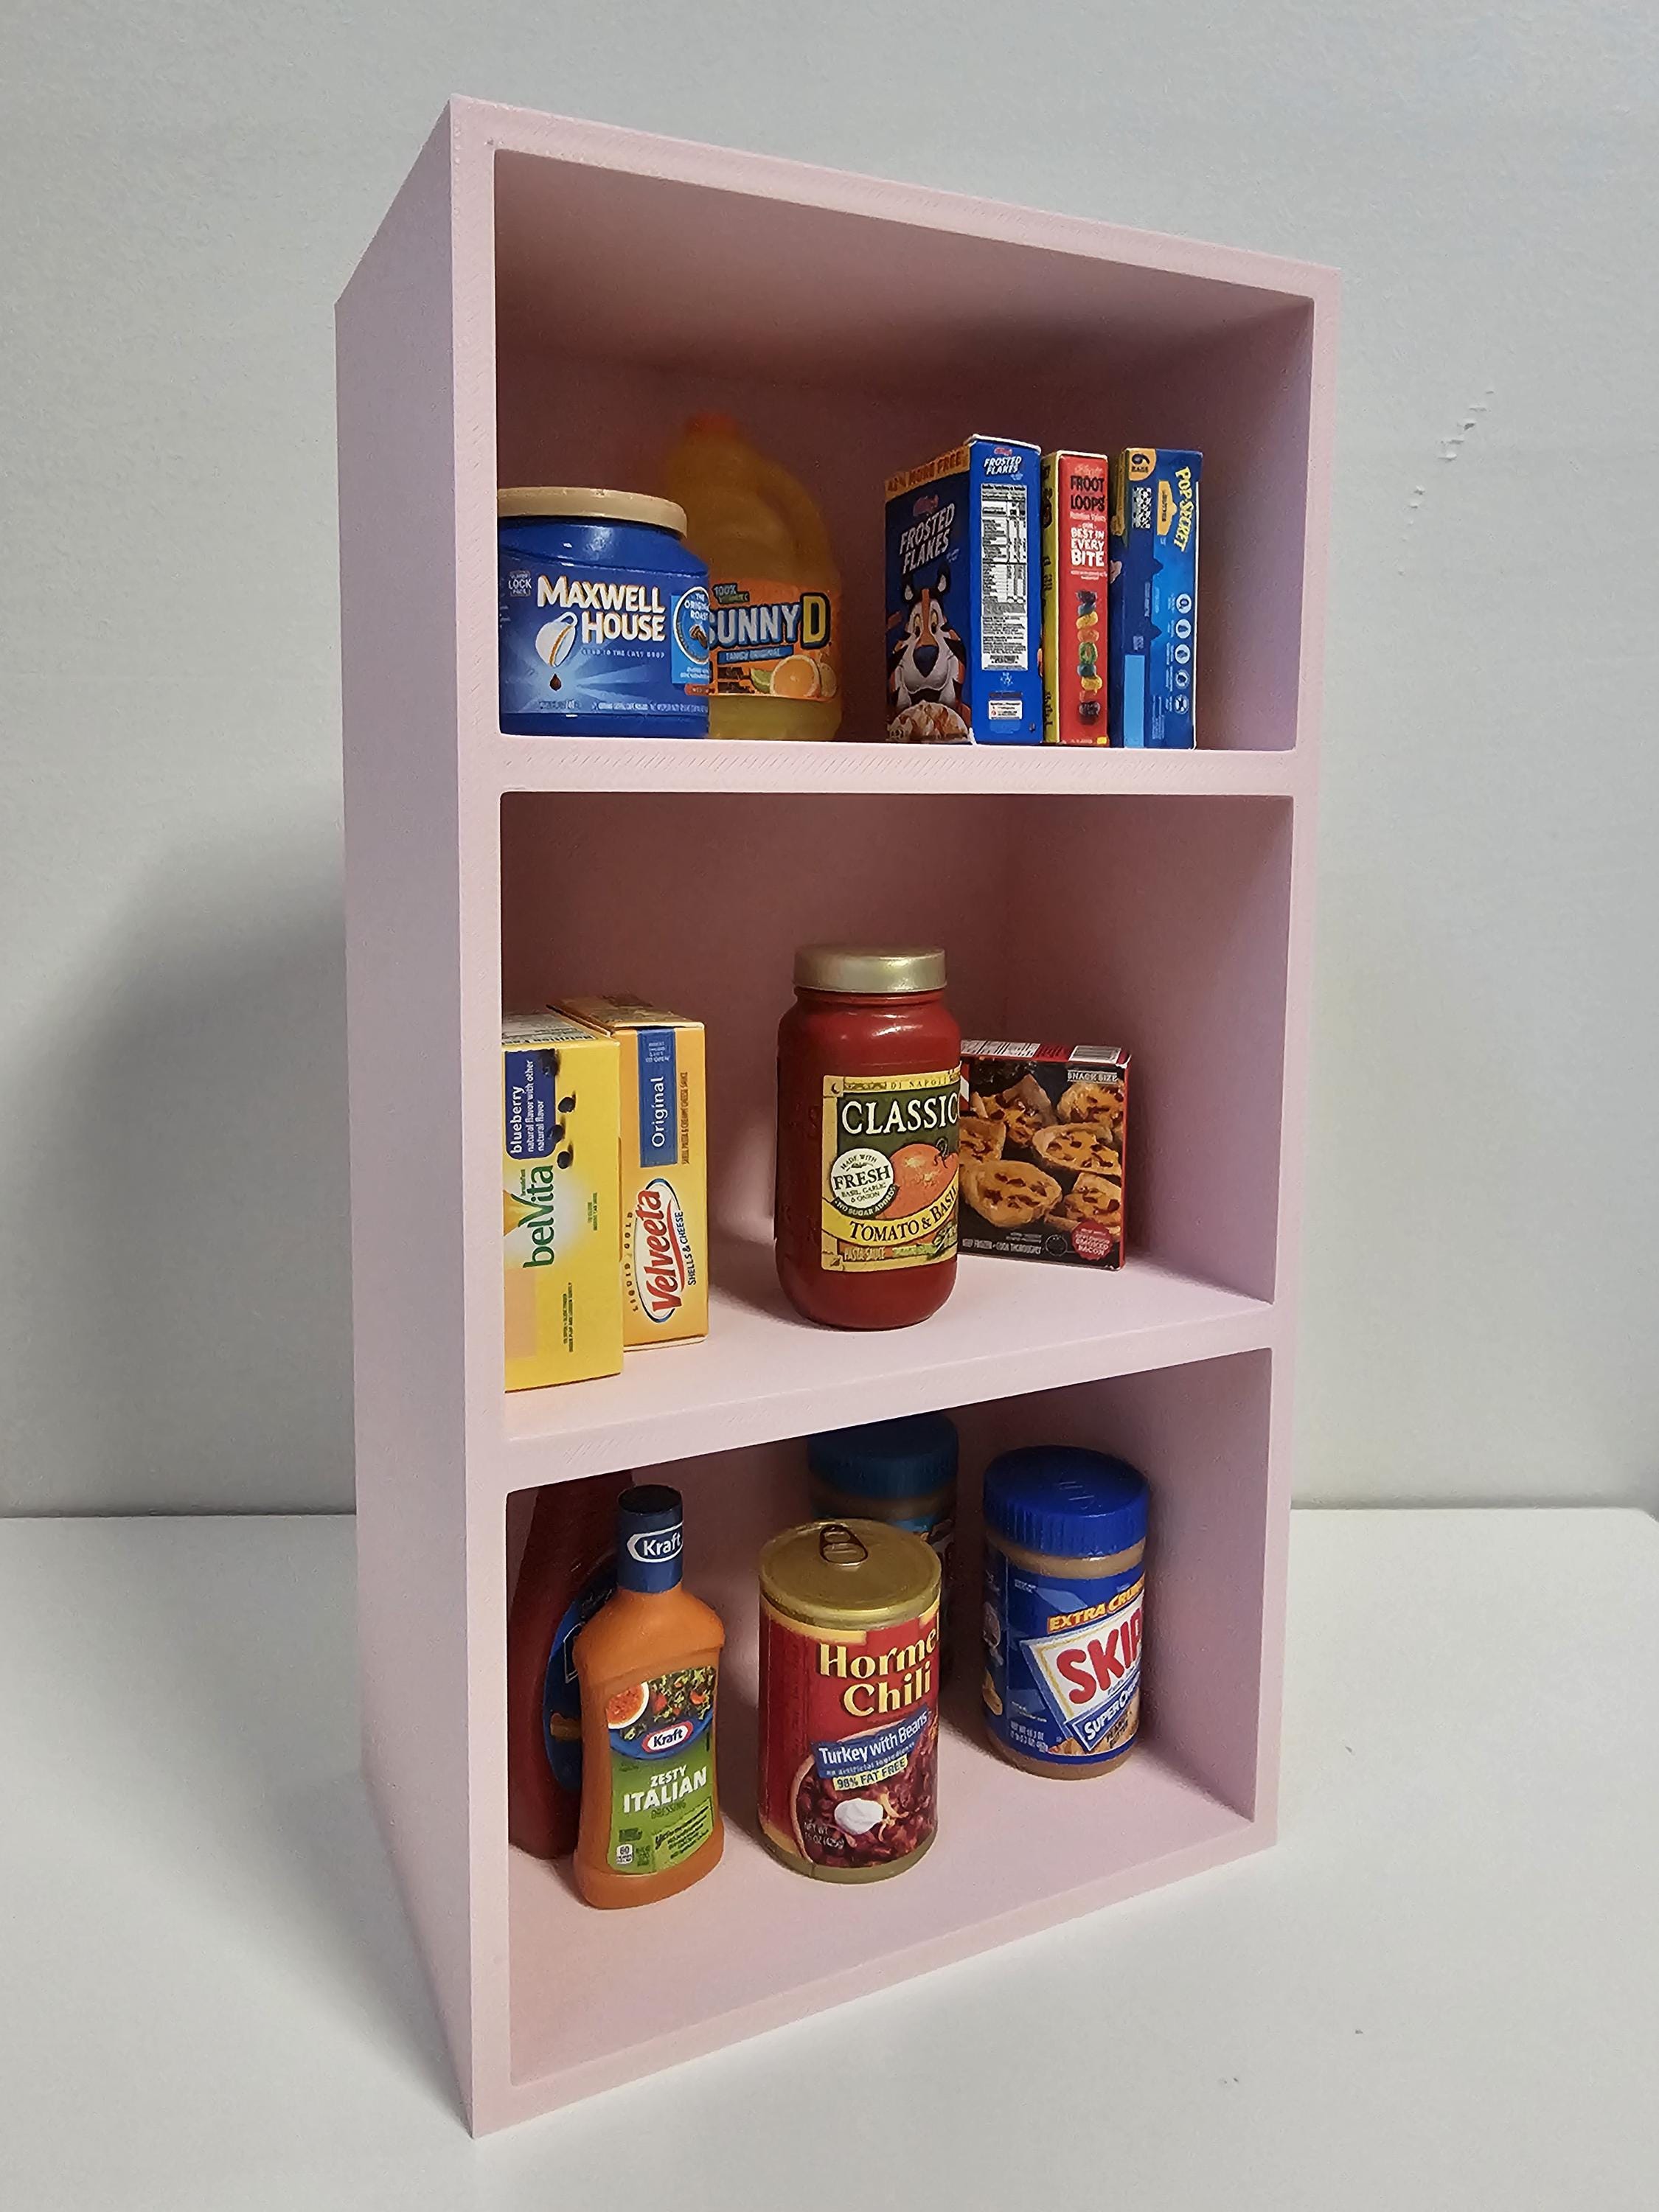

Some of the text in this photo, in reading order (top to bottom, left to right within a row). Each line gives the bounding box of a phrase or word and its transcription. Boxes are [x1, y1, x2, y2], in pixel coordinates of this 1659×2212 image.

[984, 456, 1022, 467] FROSTED
[986, 465, 1018, 476] FLAKES
[1070, 475, 1105, 493] FROOT
[1070, 494, 1106, 512] LOOPS
[899, 503, 955, 555] FROSTED
[1071, 527, 1105, 539] BEST IN
[902, 528, 950, 574] FLAKES
[1071, 538, 1105, 552] EVERY
[1071, 549, 1105, 567] BITE
[508, 578, 532, 590] LOCK
[537, 574, 666, 613] MAXWELL
[581, 611, 666, 644] HOUSE
[1067, 1071, 1119, 1082] SNACK SIZE
[509, 1086, 525, 1153] blueberry
[524, 1060, 535, 1152] natural flavor with other
[650, 1076, 668, 1148] Original
[535, 1100, 545, 1152] natural flavor
[841, 1154, 877, 1170] MADE WITH
[832, 1165, 891, 1190] FRESH
[510, 1165, 554, 1268] belVita
[848, 1208, 873, 1216] SUGAR
[849, 1220, 919, 1242] TOMATO
[921, 1217, 932, 1229] &
[624, 1211, 639, 1312] LIQUID GOLD
[637, 1189, 683, 1312] Velveeta
[674, 1211, 697, 1286] SHELLS & CHEESE
[642, 1531, 682, 1557] Kraft
[1048, 1603, 1106, 1632] EXTRA
[844, 1660, 931, 1717] Chili
[1084, 1700, 1121, 1740] SUPER
[653, 1726, 684, 1747] Kraft
[818, 1711, 928, 1764] Turkey with Beans
[650, 1764, 686, 1787] ZESTY
[836, 1757, 905, 1789] 98% FAT FREE
[623, 1765, 707, 1813] ITALIAN
